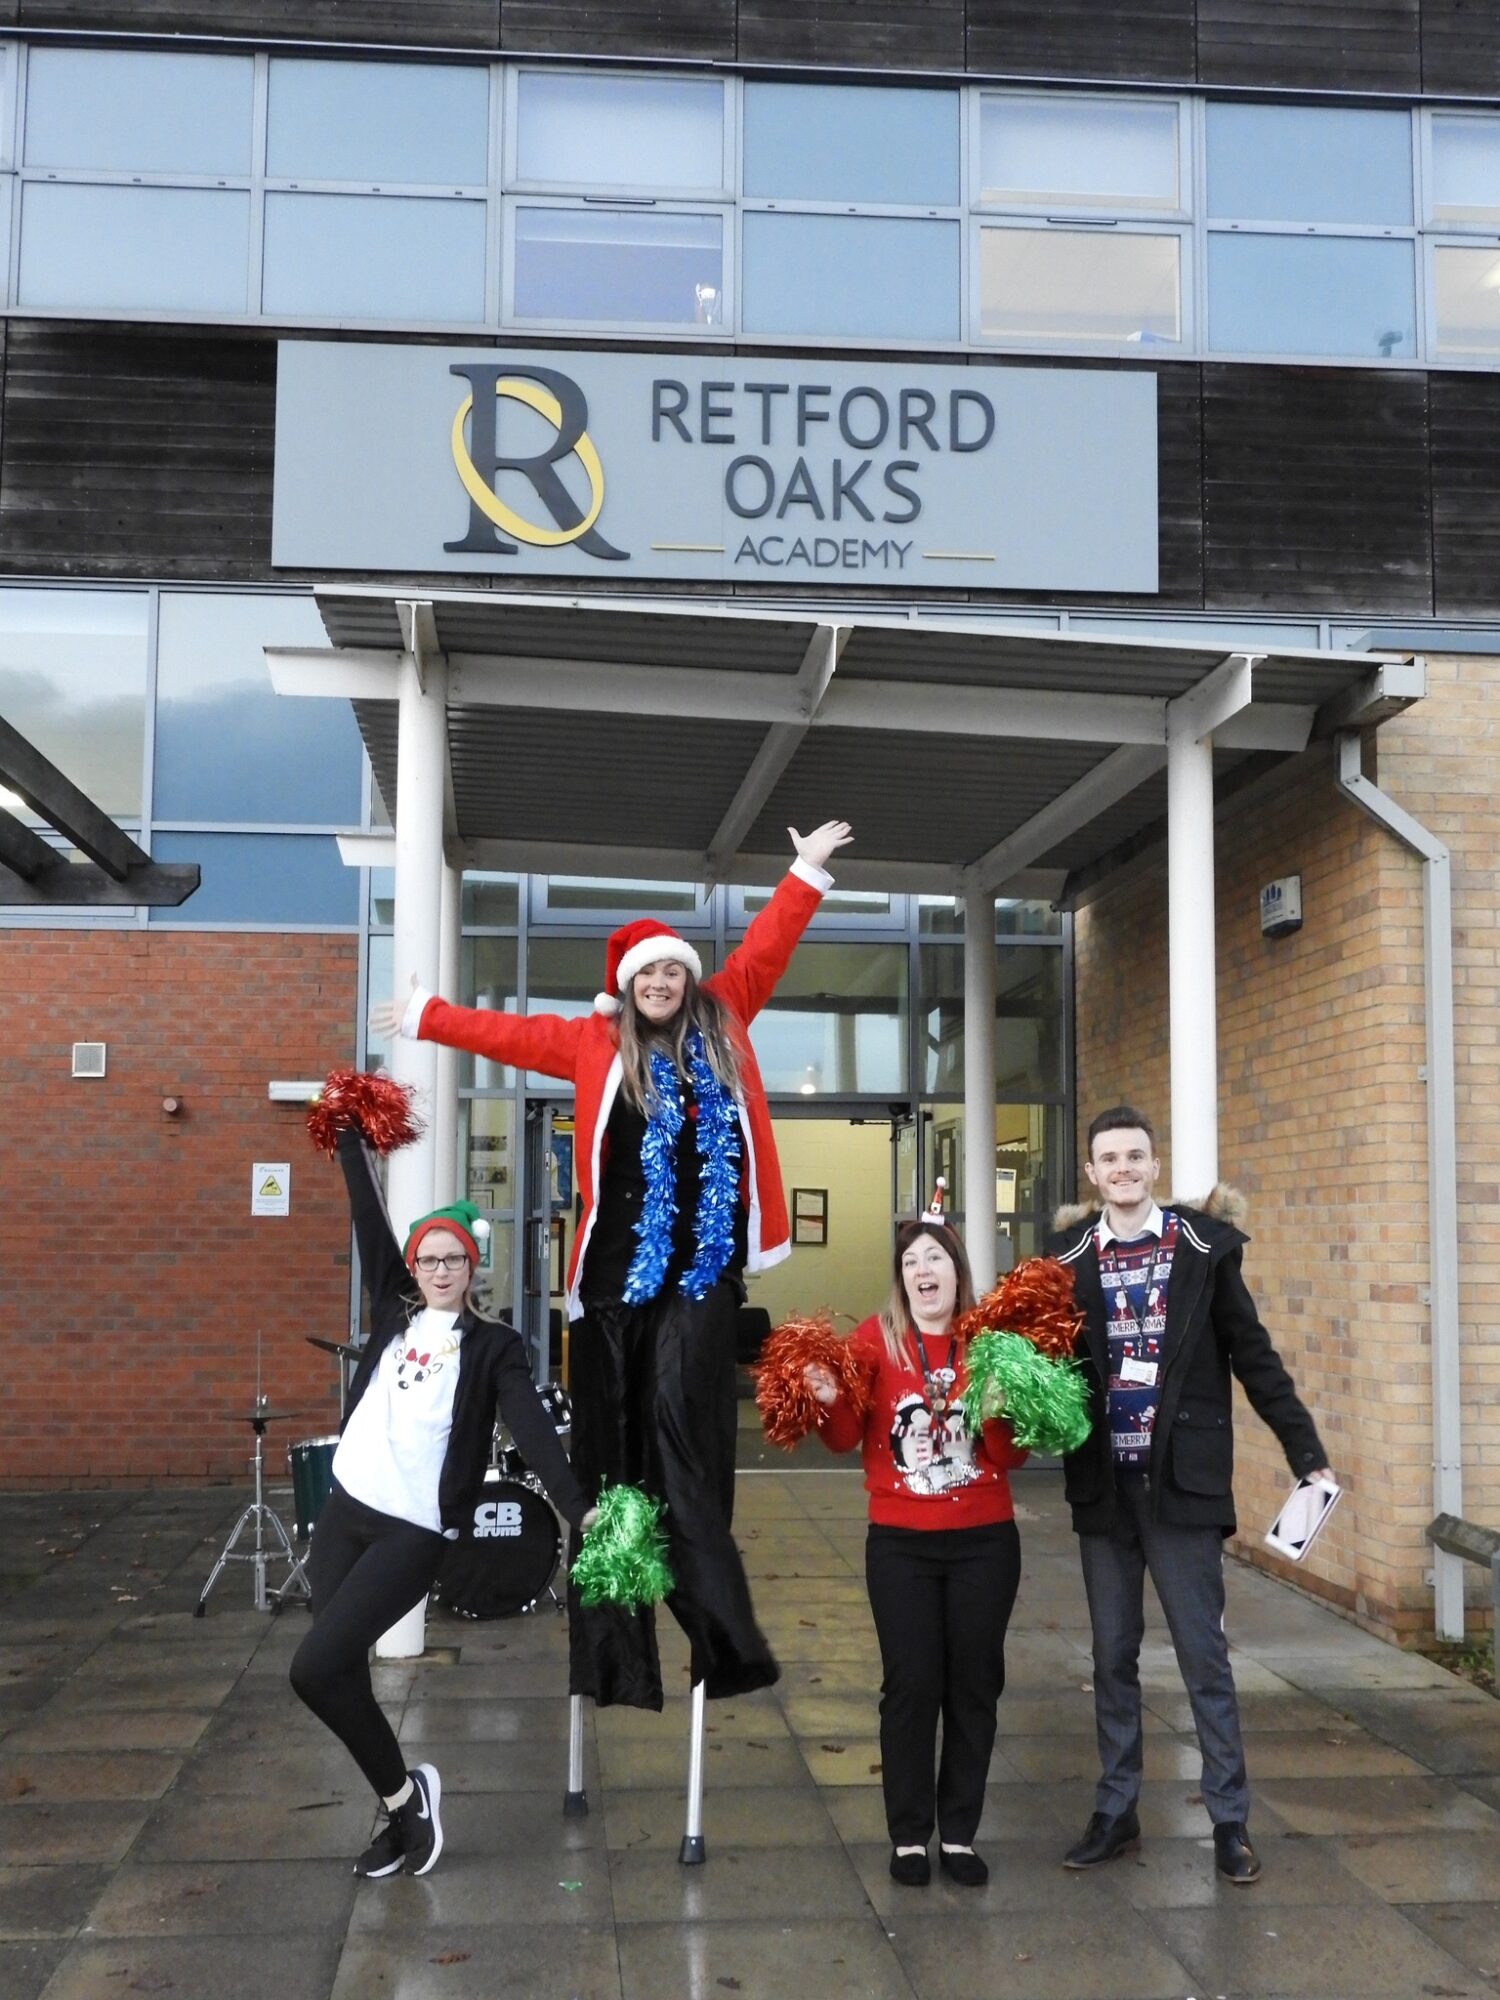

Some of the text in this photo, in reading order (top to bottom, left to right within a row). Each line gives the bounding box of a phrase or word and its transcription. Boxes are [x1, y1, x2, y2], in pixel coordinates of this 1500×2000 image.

[652, 379, 995, 453] RETFORD
[725, 454, 922, 524] OAKS
[734, 535, 914, 569] ACADEMY
[1119, 1434, 1147, 1446] MERRY
[474, 1502, 523, 1527] CB
[473, 1525, 523, 1538] drums
